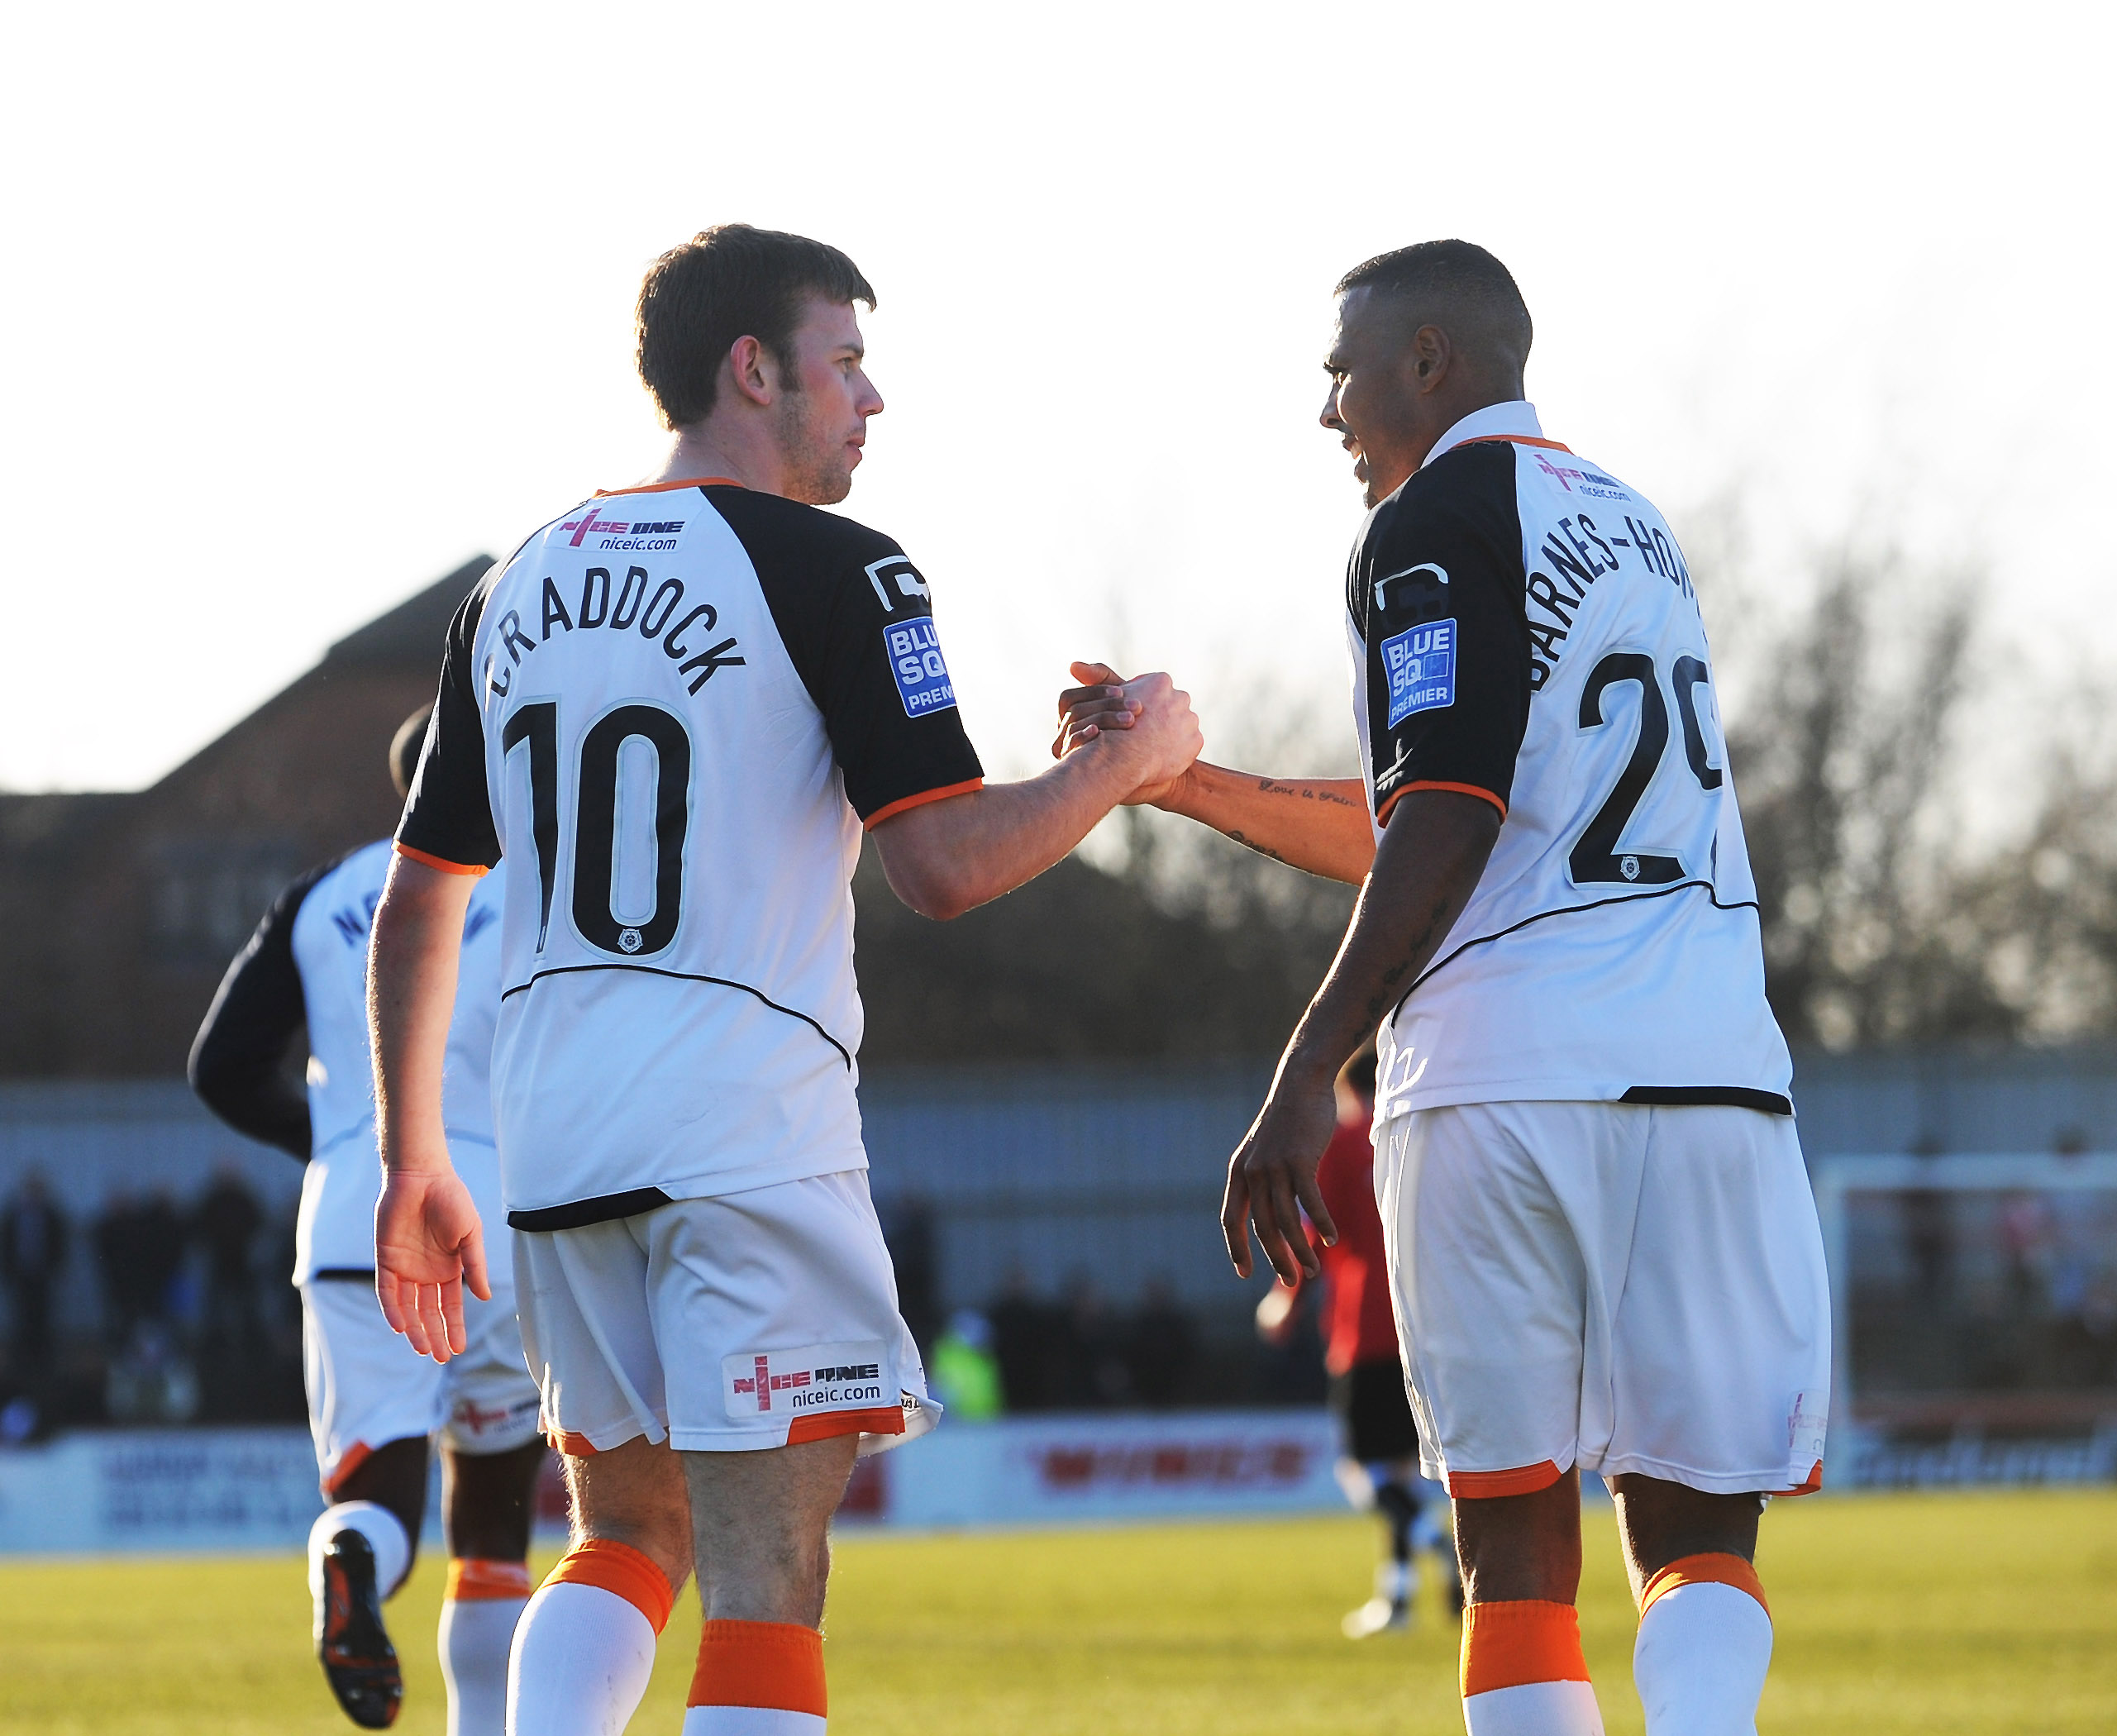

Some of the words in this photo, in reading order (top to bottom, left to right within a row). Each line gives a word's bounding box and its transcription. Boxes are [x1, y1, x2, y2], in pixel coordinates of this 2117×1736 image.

[599, 537, 677, 551] niceic.com
[630, 521, 685, 534] ONE
[484, 565, 746, 697] CRADDOCK
[890, 625, 939, 656] BLU
[1387, 627, 1450, 670] BLUE
[898, 650, 946, 685] SQ
[1393, 658, 1422, 698] SQ
[908, 685, 954, 710] PREM
[1391, 687, 1447, 721] PREMIER
[502, 701, 691, 956] 10
[793, 1385, 880, 1408] niceic.com
